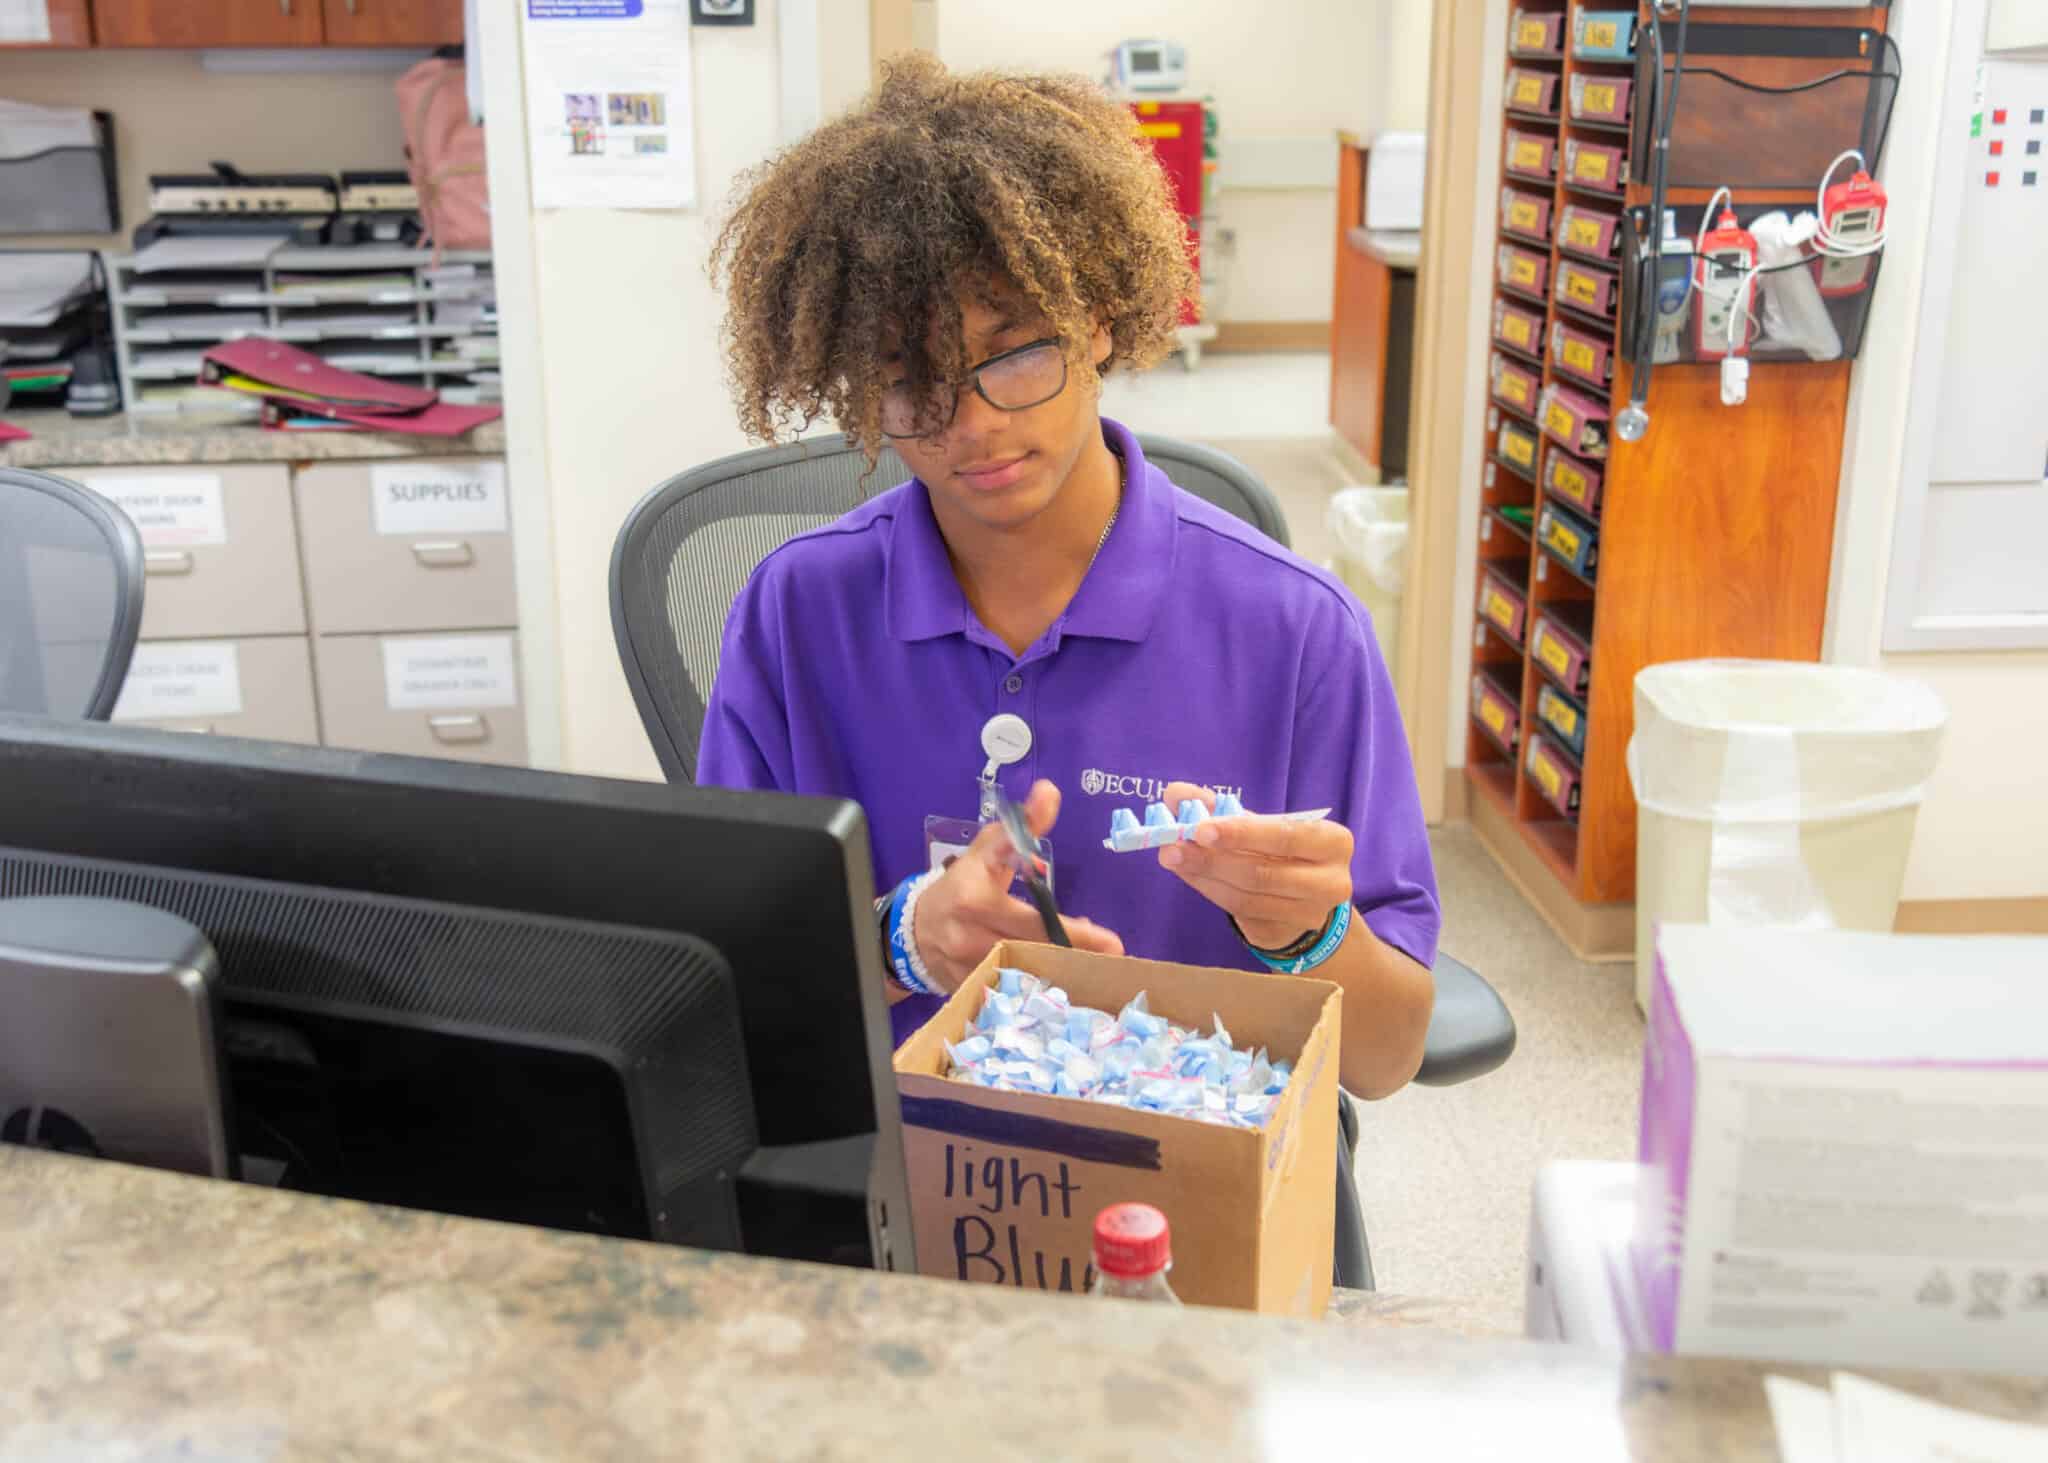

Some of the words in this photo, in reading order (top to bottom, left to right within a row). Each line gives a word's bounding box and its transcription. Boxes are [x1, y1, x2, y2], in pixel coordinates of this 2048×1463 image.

[389, 482, 488, 503] SUPPLIES
[1103, 773, 1155, 801] ECU
[944, 1144, 1081, 1217] light
